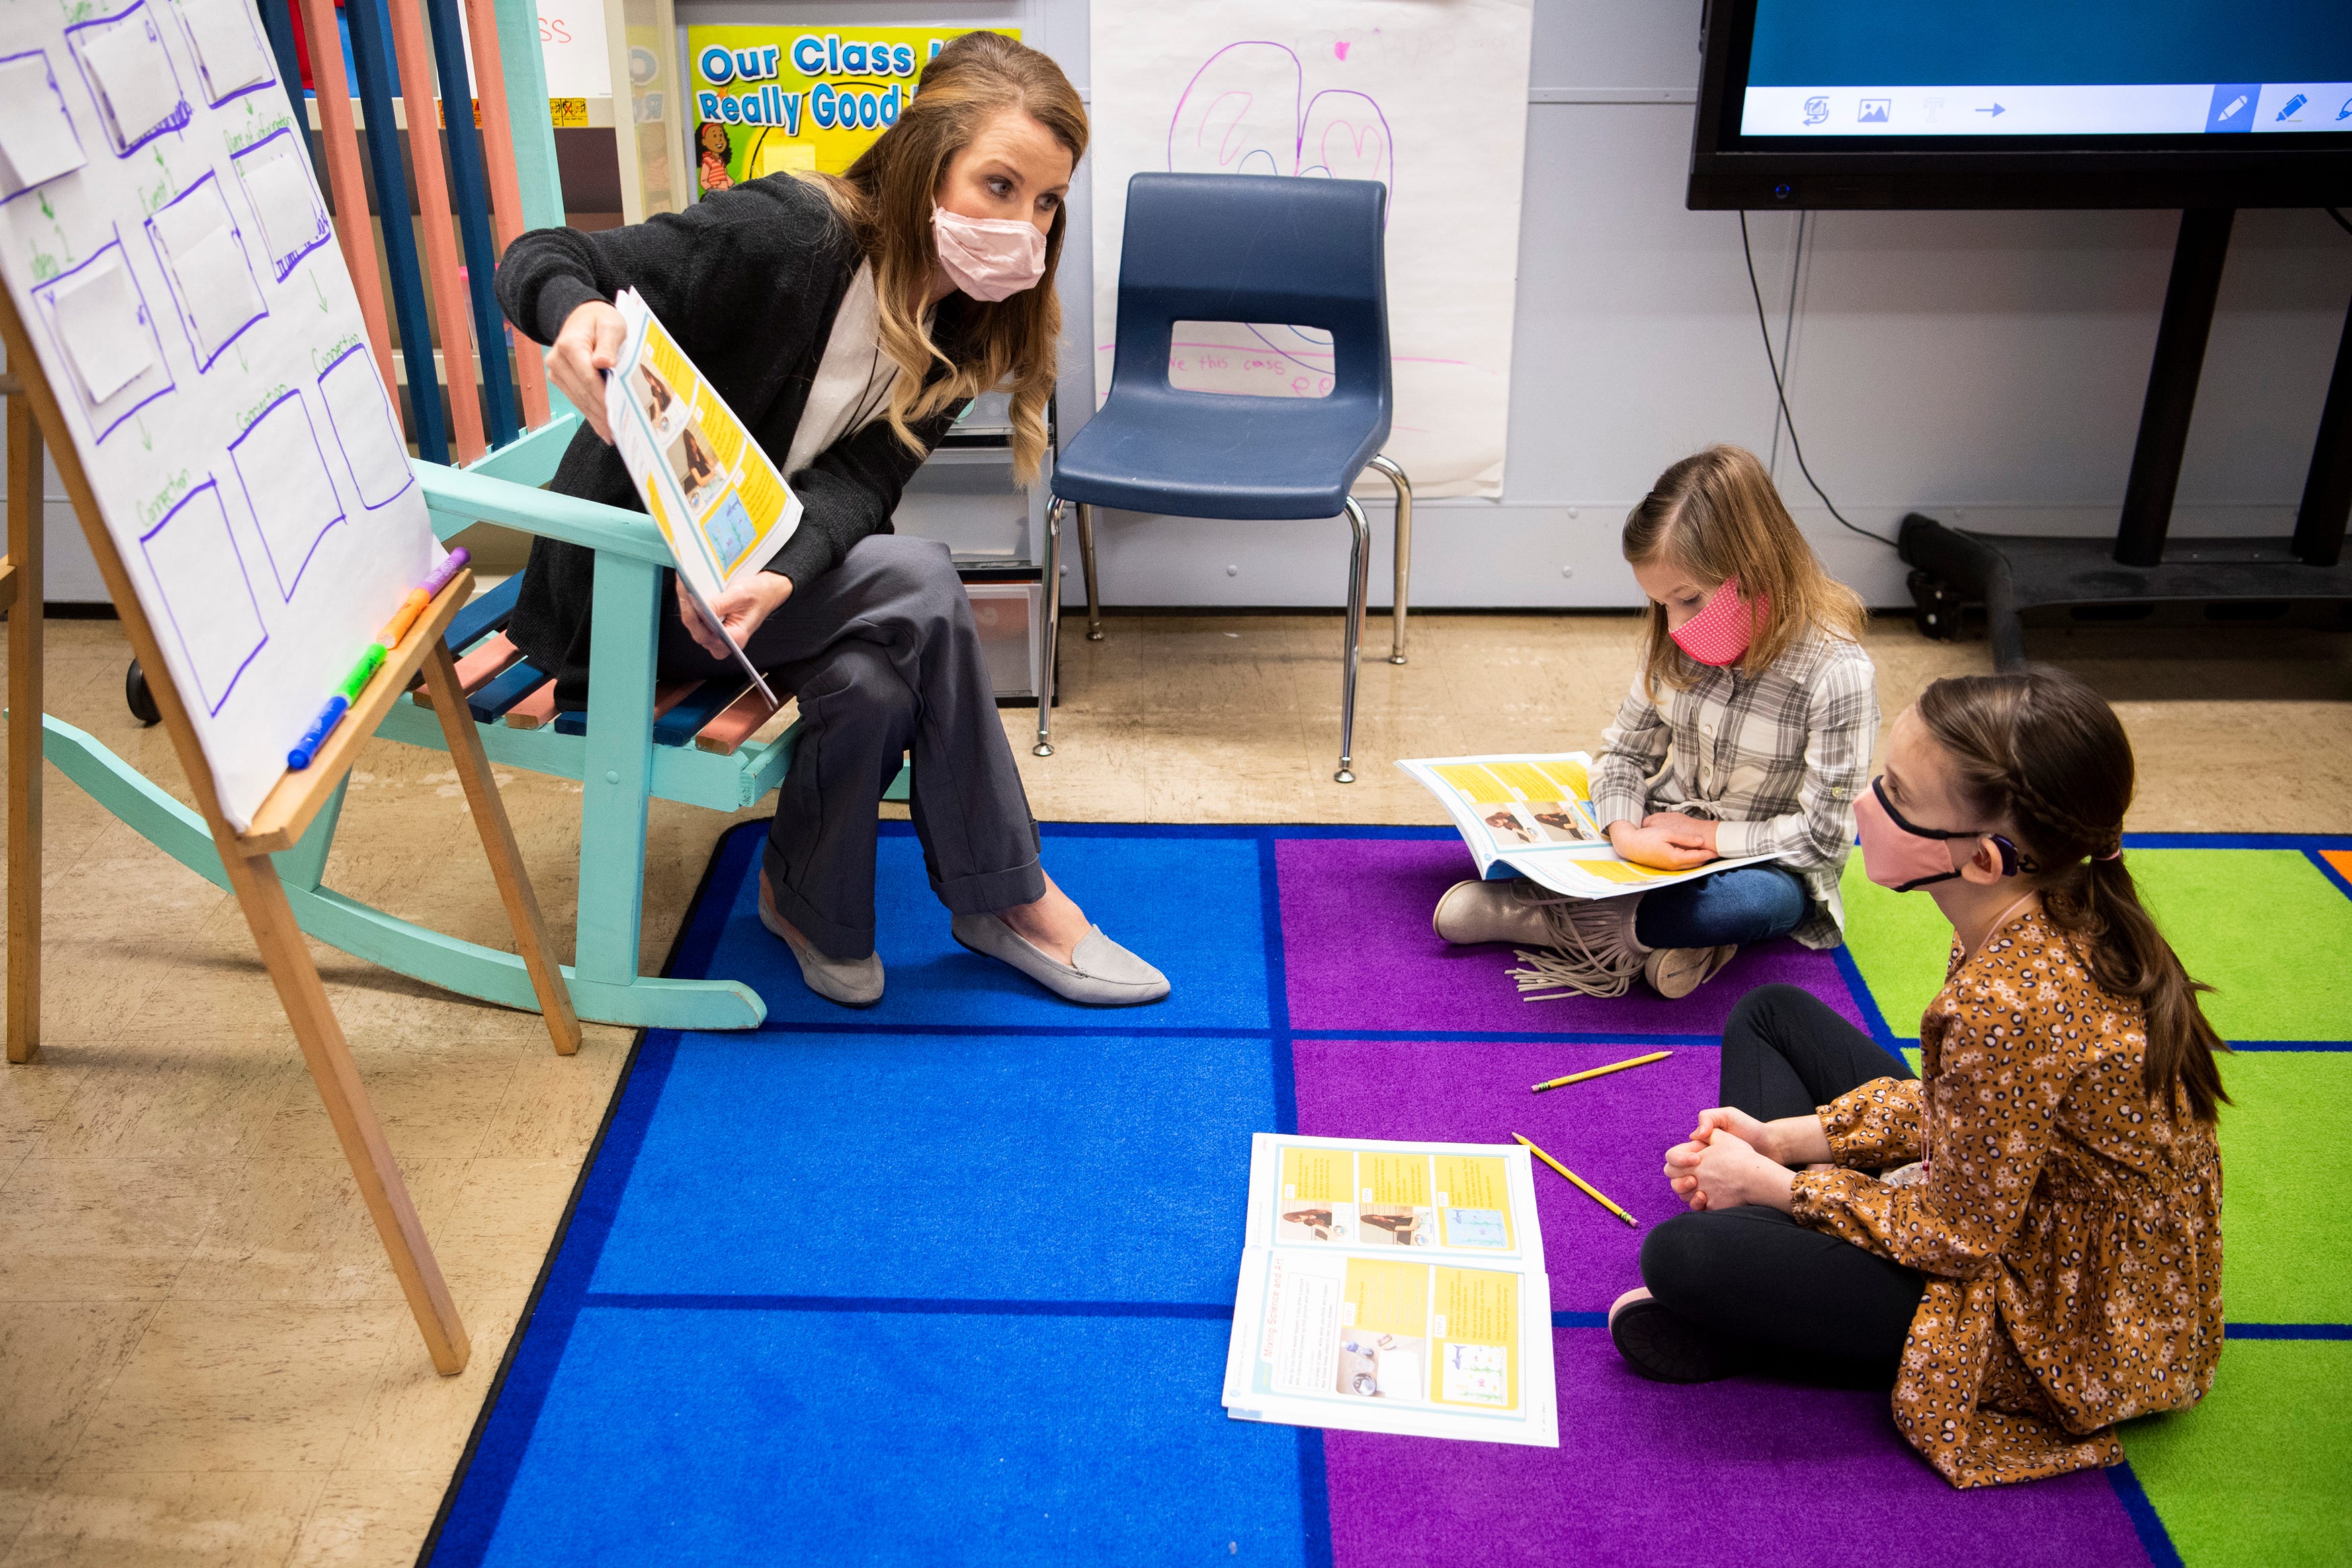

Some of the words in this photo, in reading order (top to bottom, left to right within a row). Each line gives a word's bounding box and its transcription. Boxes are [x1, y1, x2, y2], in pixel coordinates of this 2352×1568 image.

[700, 46, 779, 83] Our
[792, 36, 914, 74] Class
[697, 83, 802, 136] Really
[810, 81, 902, 130] Good
[1199, 355, 1228, 371] this
[1274, 1258, 1284, 1271] Art
[1272, 1274, 1282, 1289] and
[1267, 1292, 1280, 1324] Science
[1263, 1328, 1277, 1357] Mixing
